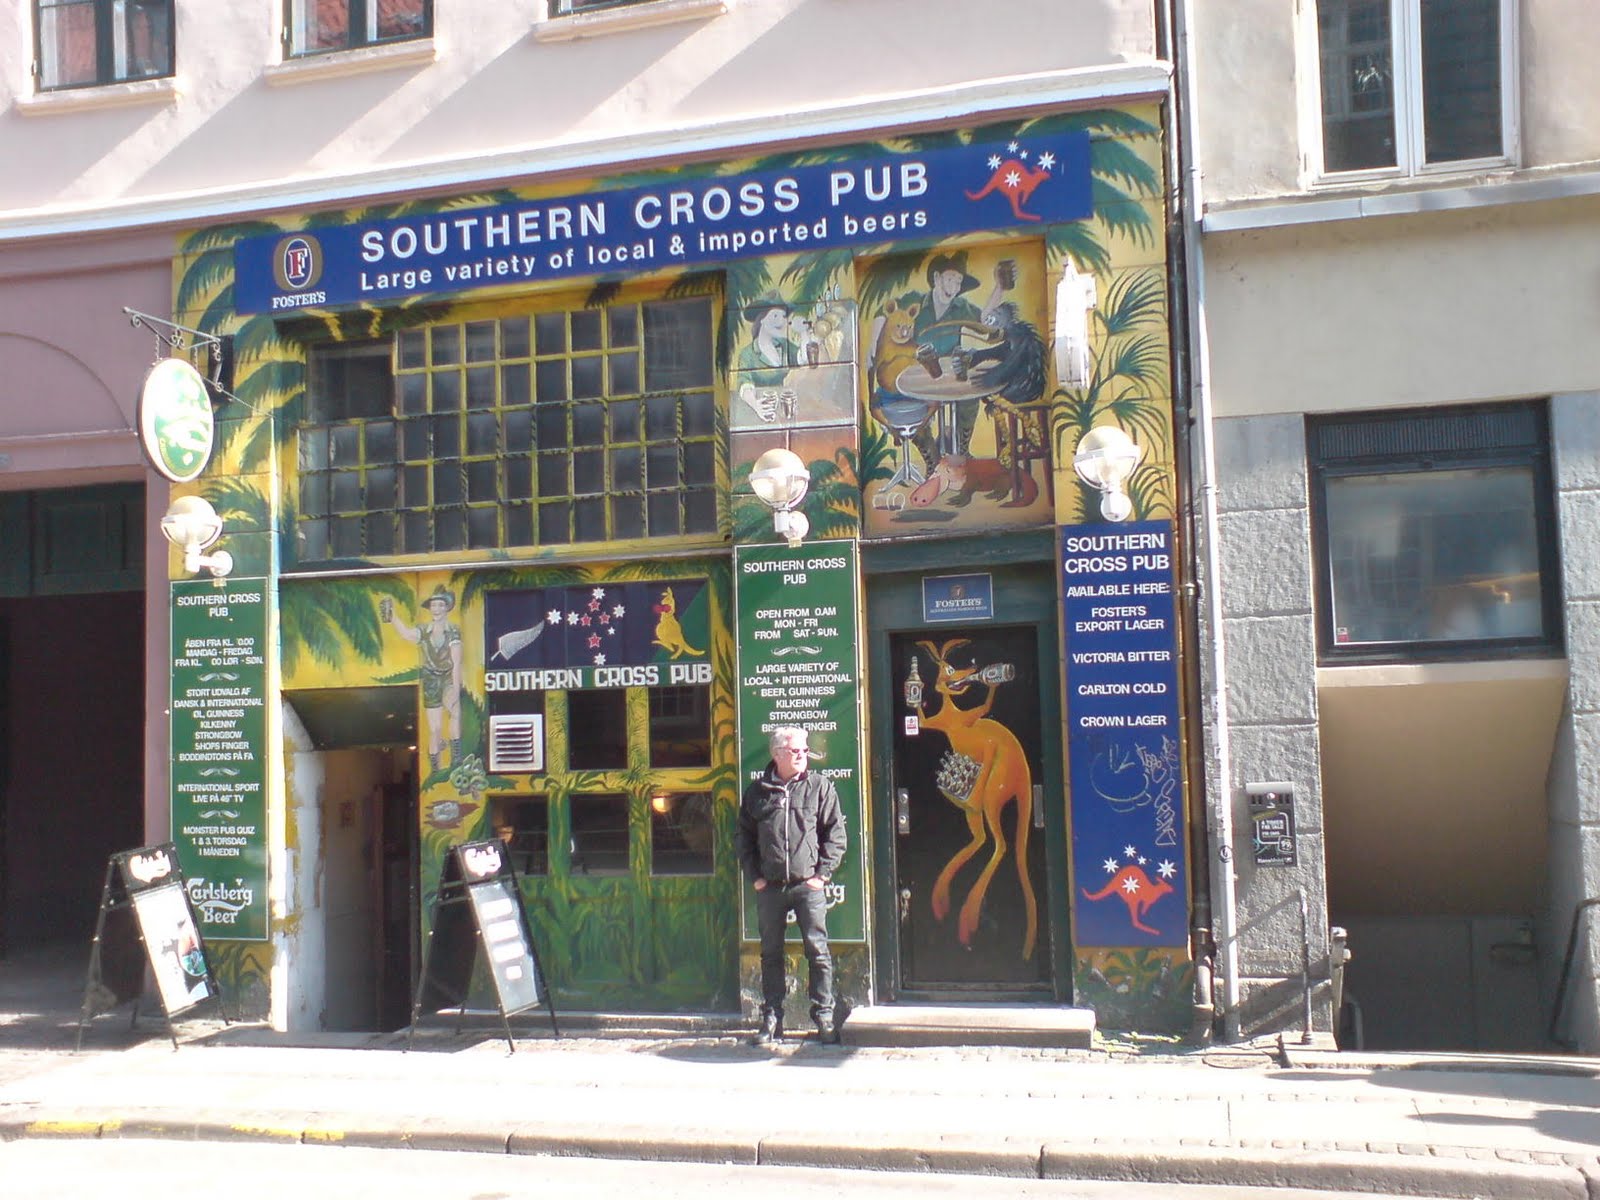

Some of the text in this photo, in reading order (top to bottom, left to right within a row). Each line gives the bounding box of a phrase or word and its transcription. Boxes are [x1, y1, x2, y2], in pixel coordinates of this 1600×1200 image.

[361, 162, 929, 263] SOUTHERN CROSS PUB
[360, 209, 928, 291] Large variety of local & imported beers
[288, 248, 308, 279] F
[272, 291, 326, 309] FOSTER'S
[1066, 533, 1165, 553] SOUTHERN
[744, 557, 846, 574] SOUTHERN CROSS
[1065, 554, 1170, 574] CROSS PUB
[783, 573, 807, 585] PUB
[1066, 584, 1131, 598] AVAILABLE
[177, 593, 261, 606] SOUTHERN CROSS
[935, 598, 982, 608] FOSTER'S
[209, 607, 229, 618] PUB
[755, 609, 781, 619] OPEN
[783, 608, 810, 618] FROM
[1091, 606, 1147, 618] FOSTER'S
[774, 619, 796, 628] MON
[804, 618, 818, 627] FRI
[1075, 619, 1165, 632] EXPORT LAGER
[754, 630, 781, 640] FROM
[793, 629, 810, 638] SAT
[206, 639, 221, 647] FRA
[186, 648, 217, 657] MANDAG
[223, 647, 253, 656] FREDAG
[1073, 651, 1170, 664] VICTORIA BITTER
[175, 659, 190, 667] FRA
[756, 662, 839, 674] LARGE VARIETY OF
[485, 663, 712, 692] SOUTHERN CROSS PUB
[744, 677, 773, 686] LOCAL
[782, 673, 852, 685] INTERNATIONAL
[186, 687, 251, 697] STORT UDVALG AF
[760, 686, 835, 697] BEER, GUINNESS
[1078, 682, 1166, 695] CARLTON COLD
[174, 700, 199, 708] DANSK
[207, 698, 264, 707] INTERNATIONAL
[776, 698, 821, 708] KILKENNY
[206, 709, 245, 718] GUINNESS
[769, 710, 828, 720] STRONGBOW
[200, 720, 237, 729] KILKENNY
[803, 721, 837, 731] FINGER
[1080, 715, 1167, 728] CROWN LAGER
[195, 731, 243, 739] STRONGBOW
[221, 741, 249, 750] FINGER
[821, 768, 853, 778] SPORT
[178, 783, 260, 792] INTERNATIONAL SPORT
[192, 794, 208, 803] LIVE
[234, 794, 244, 803] TV
[183, 826, 256, 834] MONSTER PUB QUIZ
[212, 837, 247, 845] TORSDAG
[186, 878, 253, 906] Carlsberg
[203, 908, 238, 923] Beer
